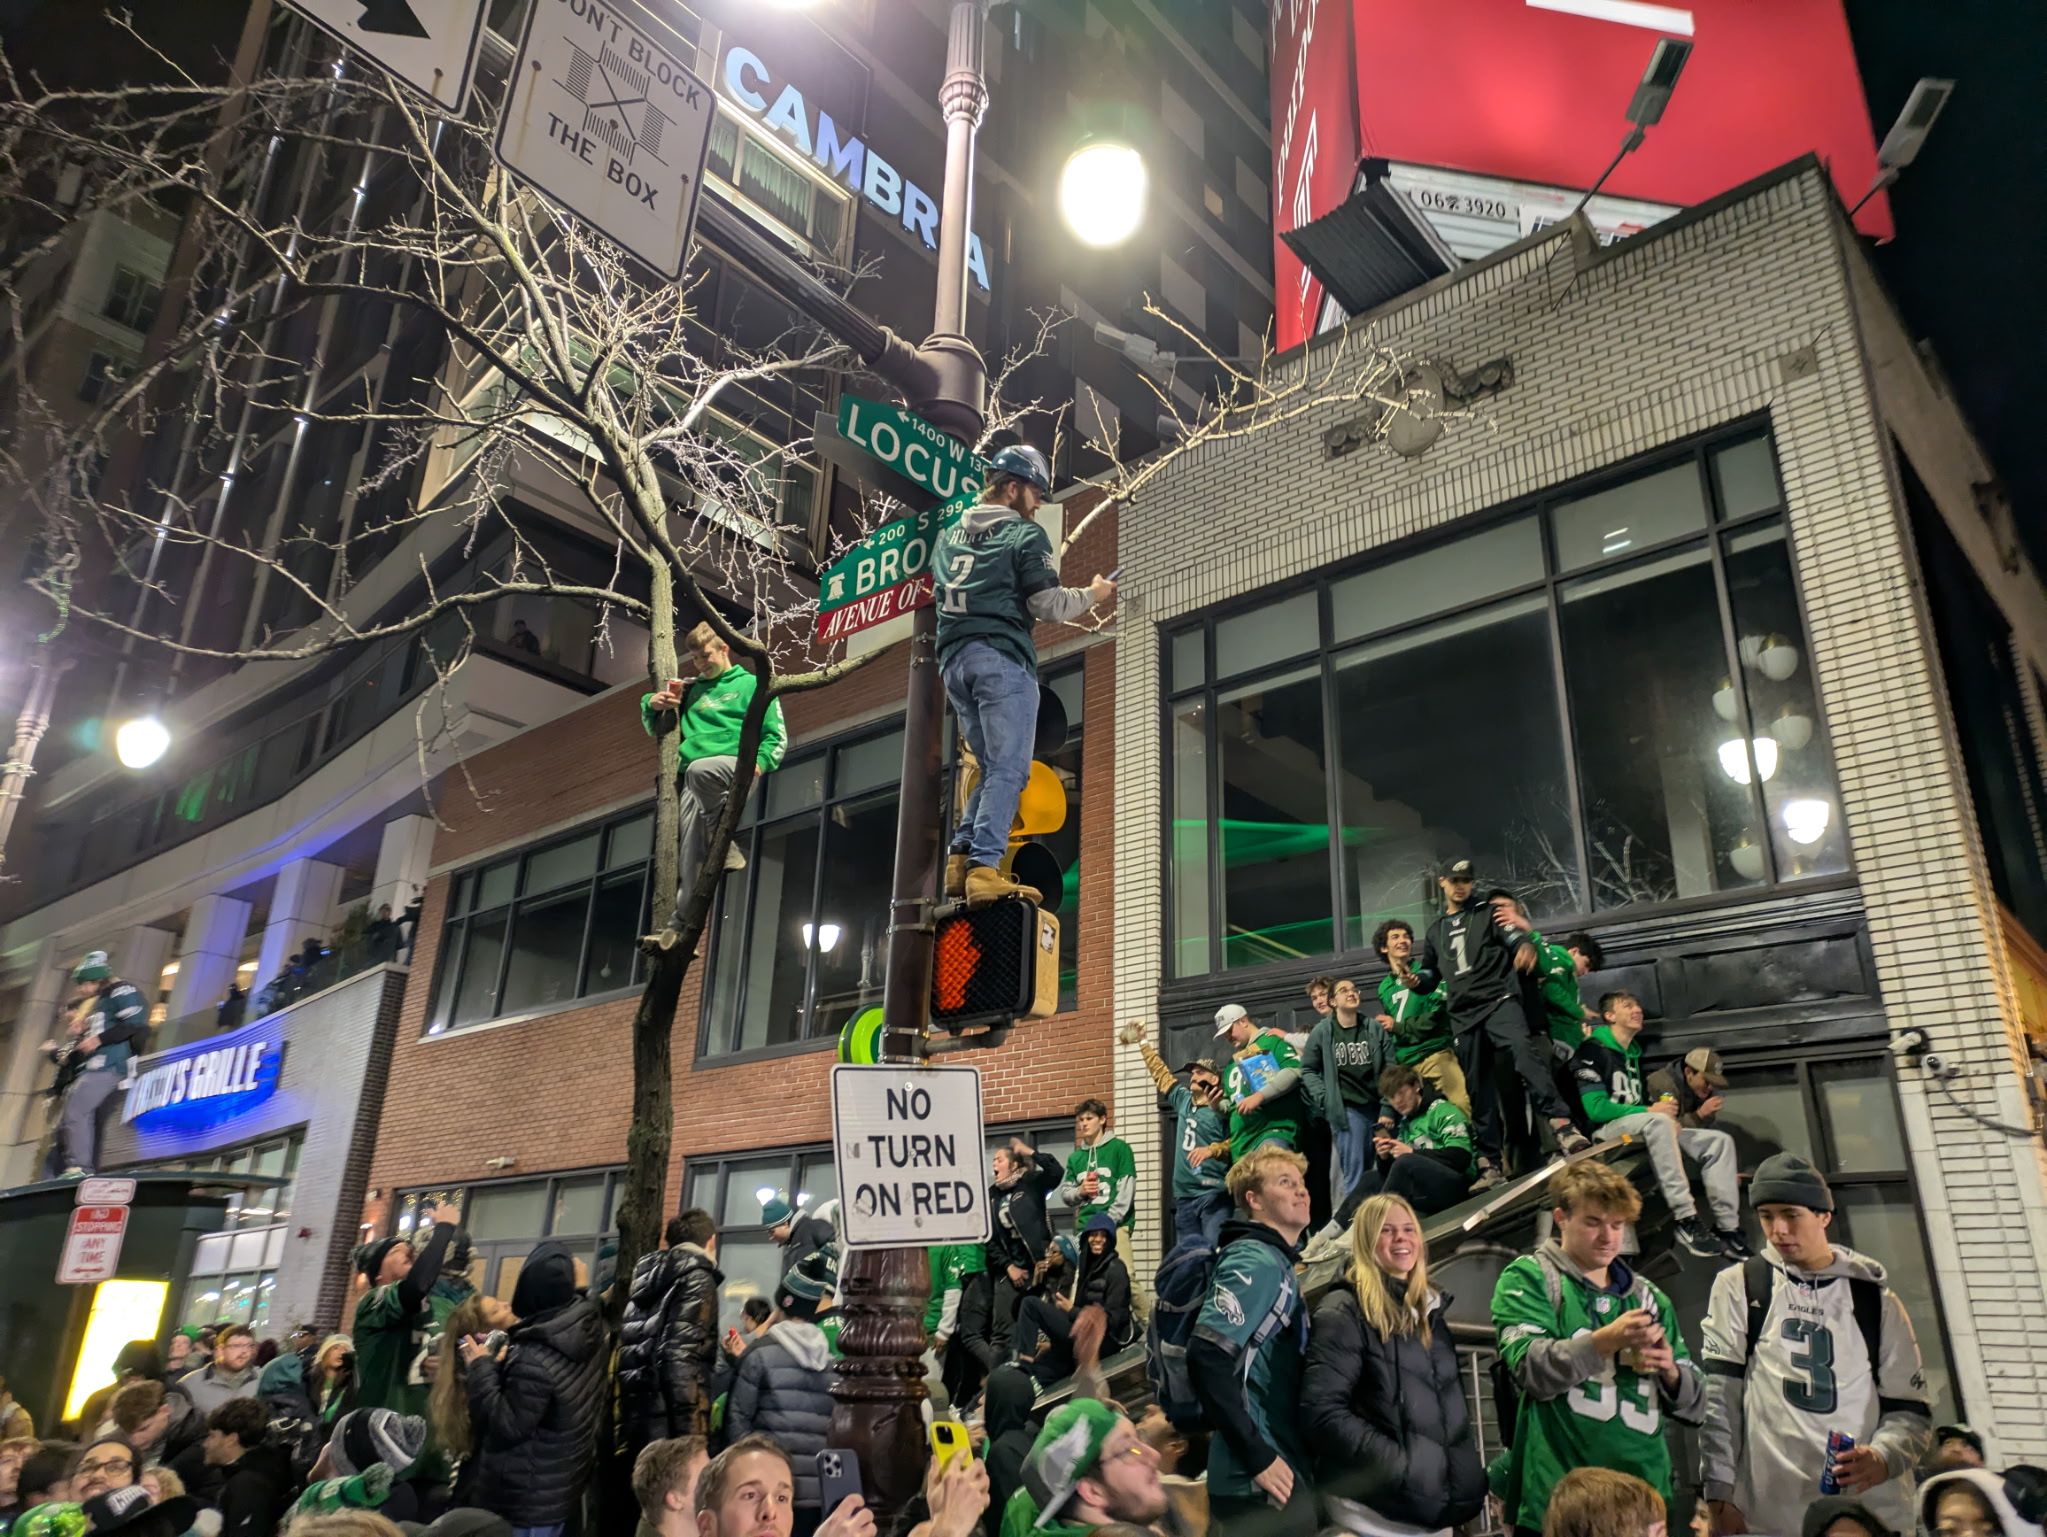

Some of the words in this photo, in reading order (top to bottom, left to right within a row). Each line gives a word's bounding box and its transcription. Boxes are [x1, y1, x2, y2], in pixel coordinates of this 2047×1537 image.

[558, 0, 623, 42] ON'T
[628, 37, 701, 111] BLOCK
[548, 112, 597, 166] THE
[607, 158, 659, 211] BOX
[725, 46, 990, 291] CAMBRA
[911, 418, 945, 448] 1400
[949, 438, 965, 463] W
[879, 524, 905, 546] 200
[918, 512, 929, 531] S
[937, 500, 963, 521] 299
[942, 554, 975, 612] 2
[823, 587, 898, 640] AVENUE
[900, 578, 925, 605] OF
[1449, 935, 1472, 976] 1
[1392, 988, 1410, 1023] 7
[887, 1088, 931, 1120] NO
[1228, 1066, 1247, 1103] 9
[867, 1134, 956, 1168] TURN
[1182, 1118, 1198, 1151] 6
[855, 1183, 902, 1217] ON
[912, 1181, 974, 1215] RED
[1788, 1303, 1825, 1316] EAGLES
[1781, 1317, 1838, 1414] 3
